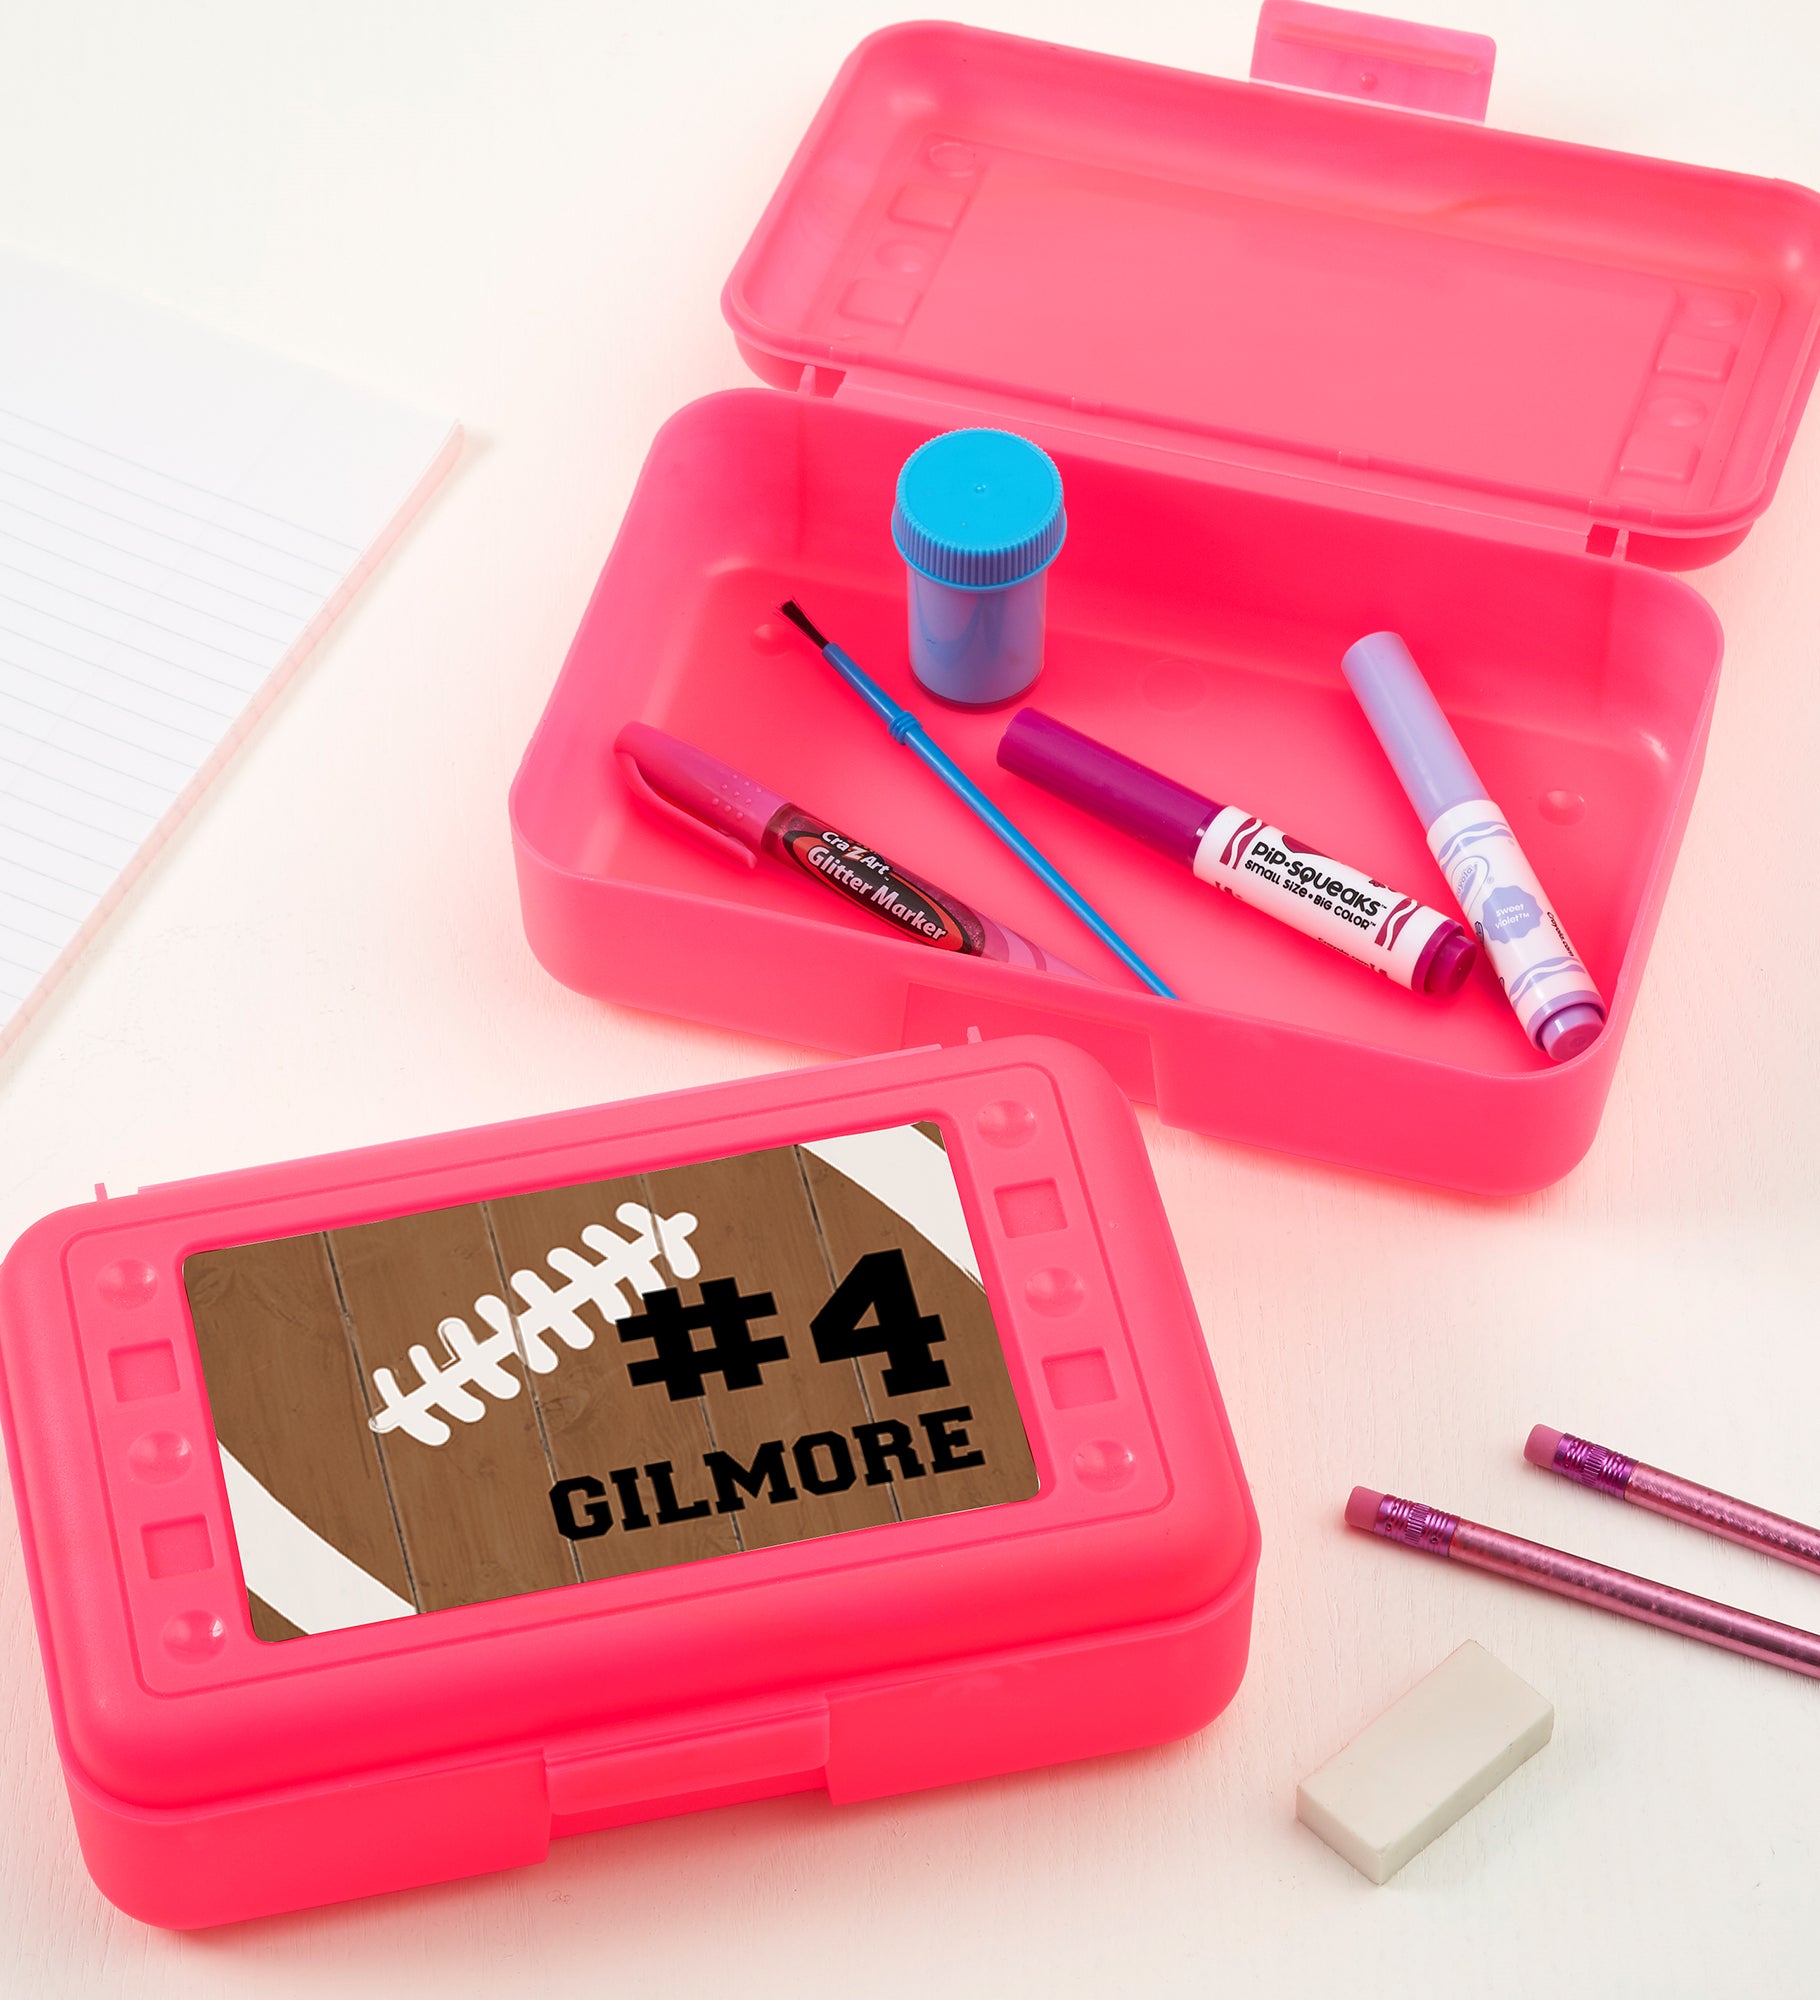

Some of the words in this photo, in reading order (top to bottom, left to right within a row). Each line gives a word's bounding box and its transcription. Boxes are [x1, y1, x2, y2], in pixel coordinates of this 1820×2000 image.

[807, 846, 873, 896] Glitter
[870, 884, 947, 940] Marker
[1495, 903, 1524, 917] sweet
[614, 1248, 952, 1402] #4
[548, 1405, 986, 1541] GILMORE
